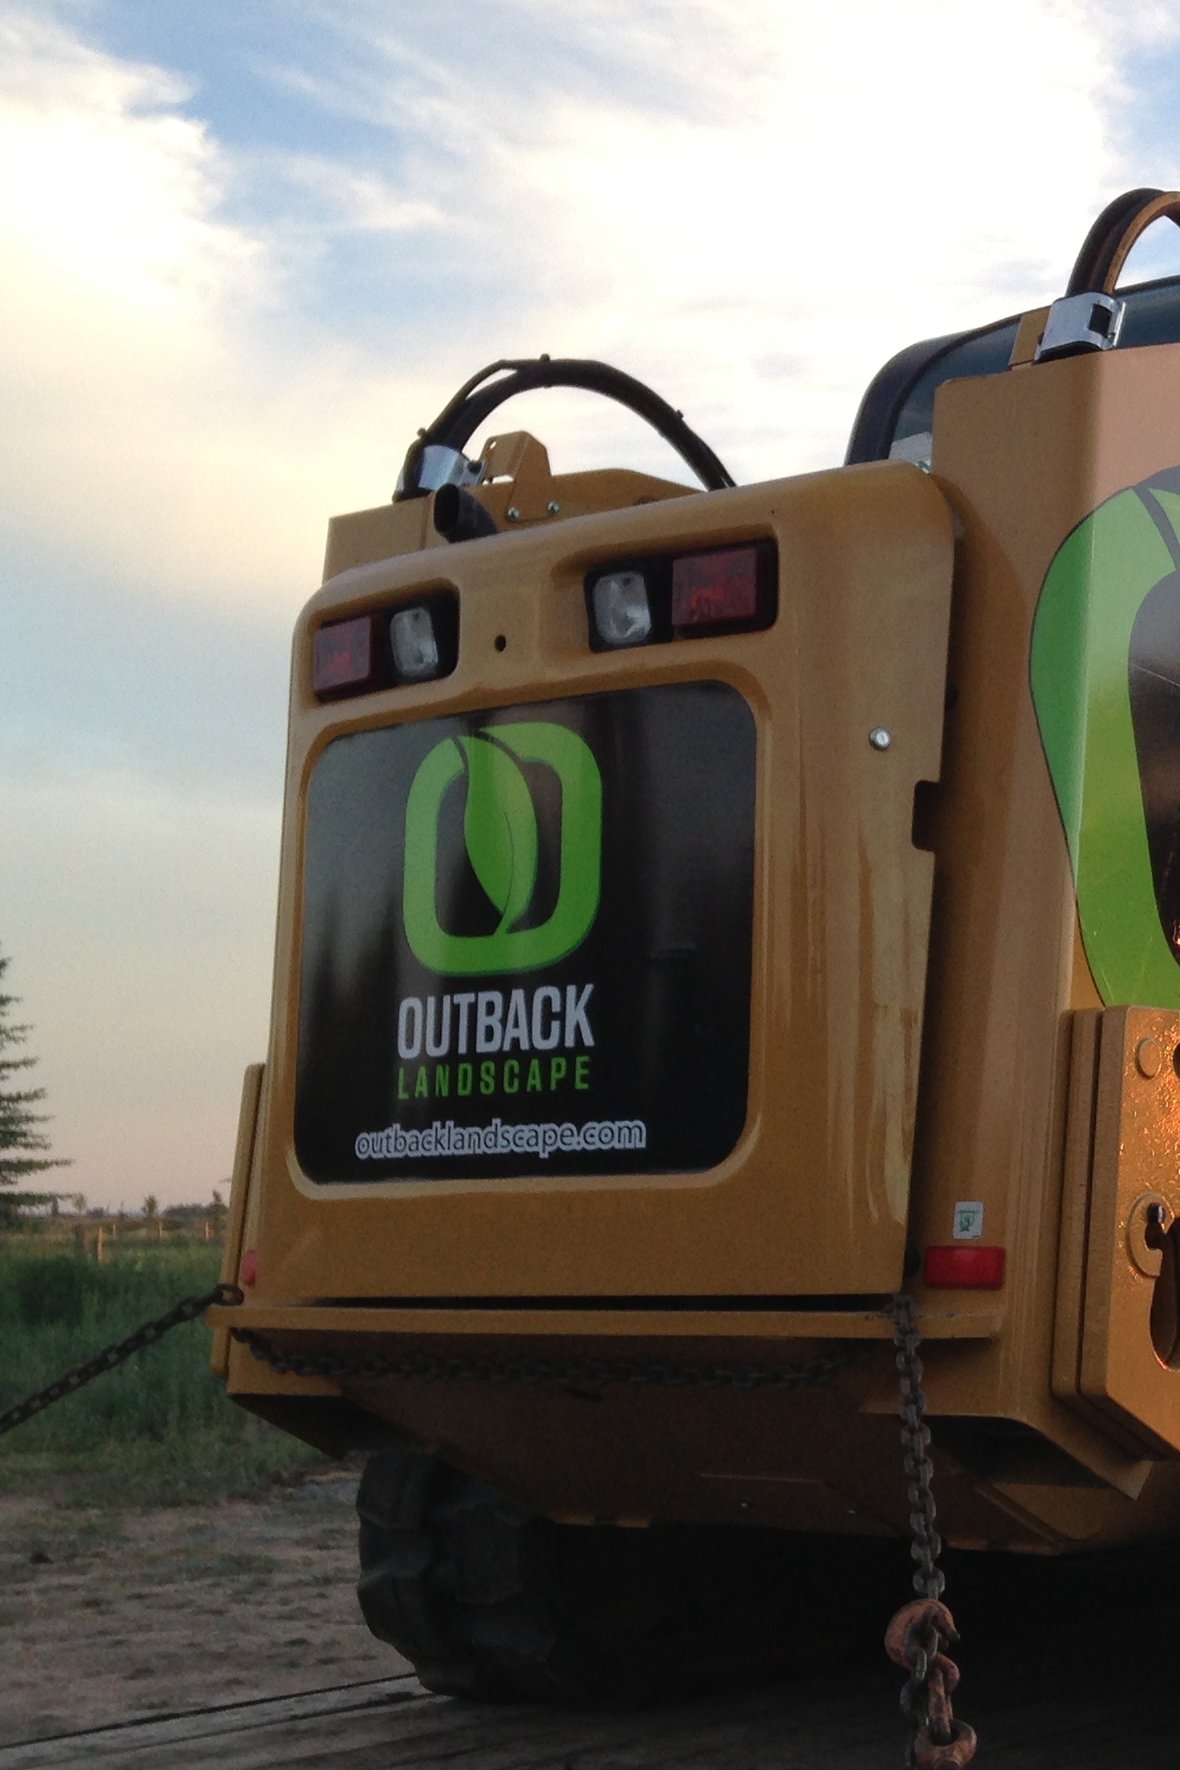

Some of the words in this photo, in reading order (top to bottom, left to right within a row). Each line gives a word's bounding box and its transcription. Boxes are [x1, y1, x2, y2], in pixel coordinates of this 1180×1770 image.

[396, 983, 595, 1060] OUTBACK
[397, 1056, 591, 1100] LANDSCAPE
[354, 1118, 647, 1159] outbacklandscape.com
